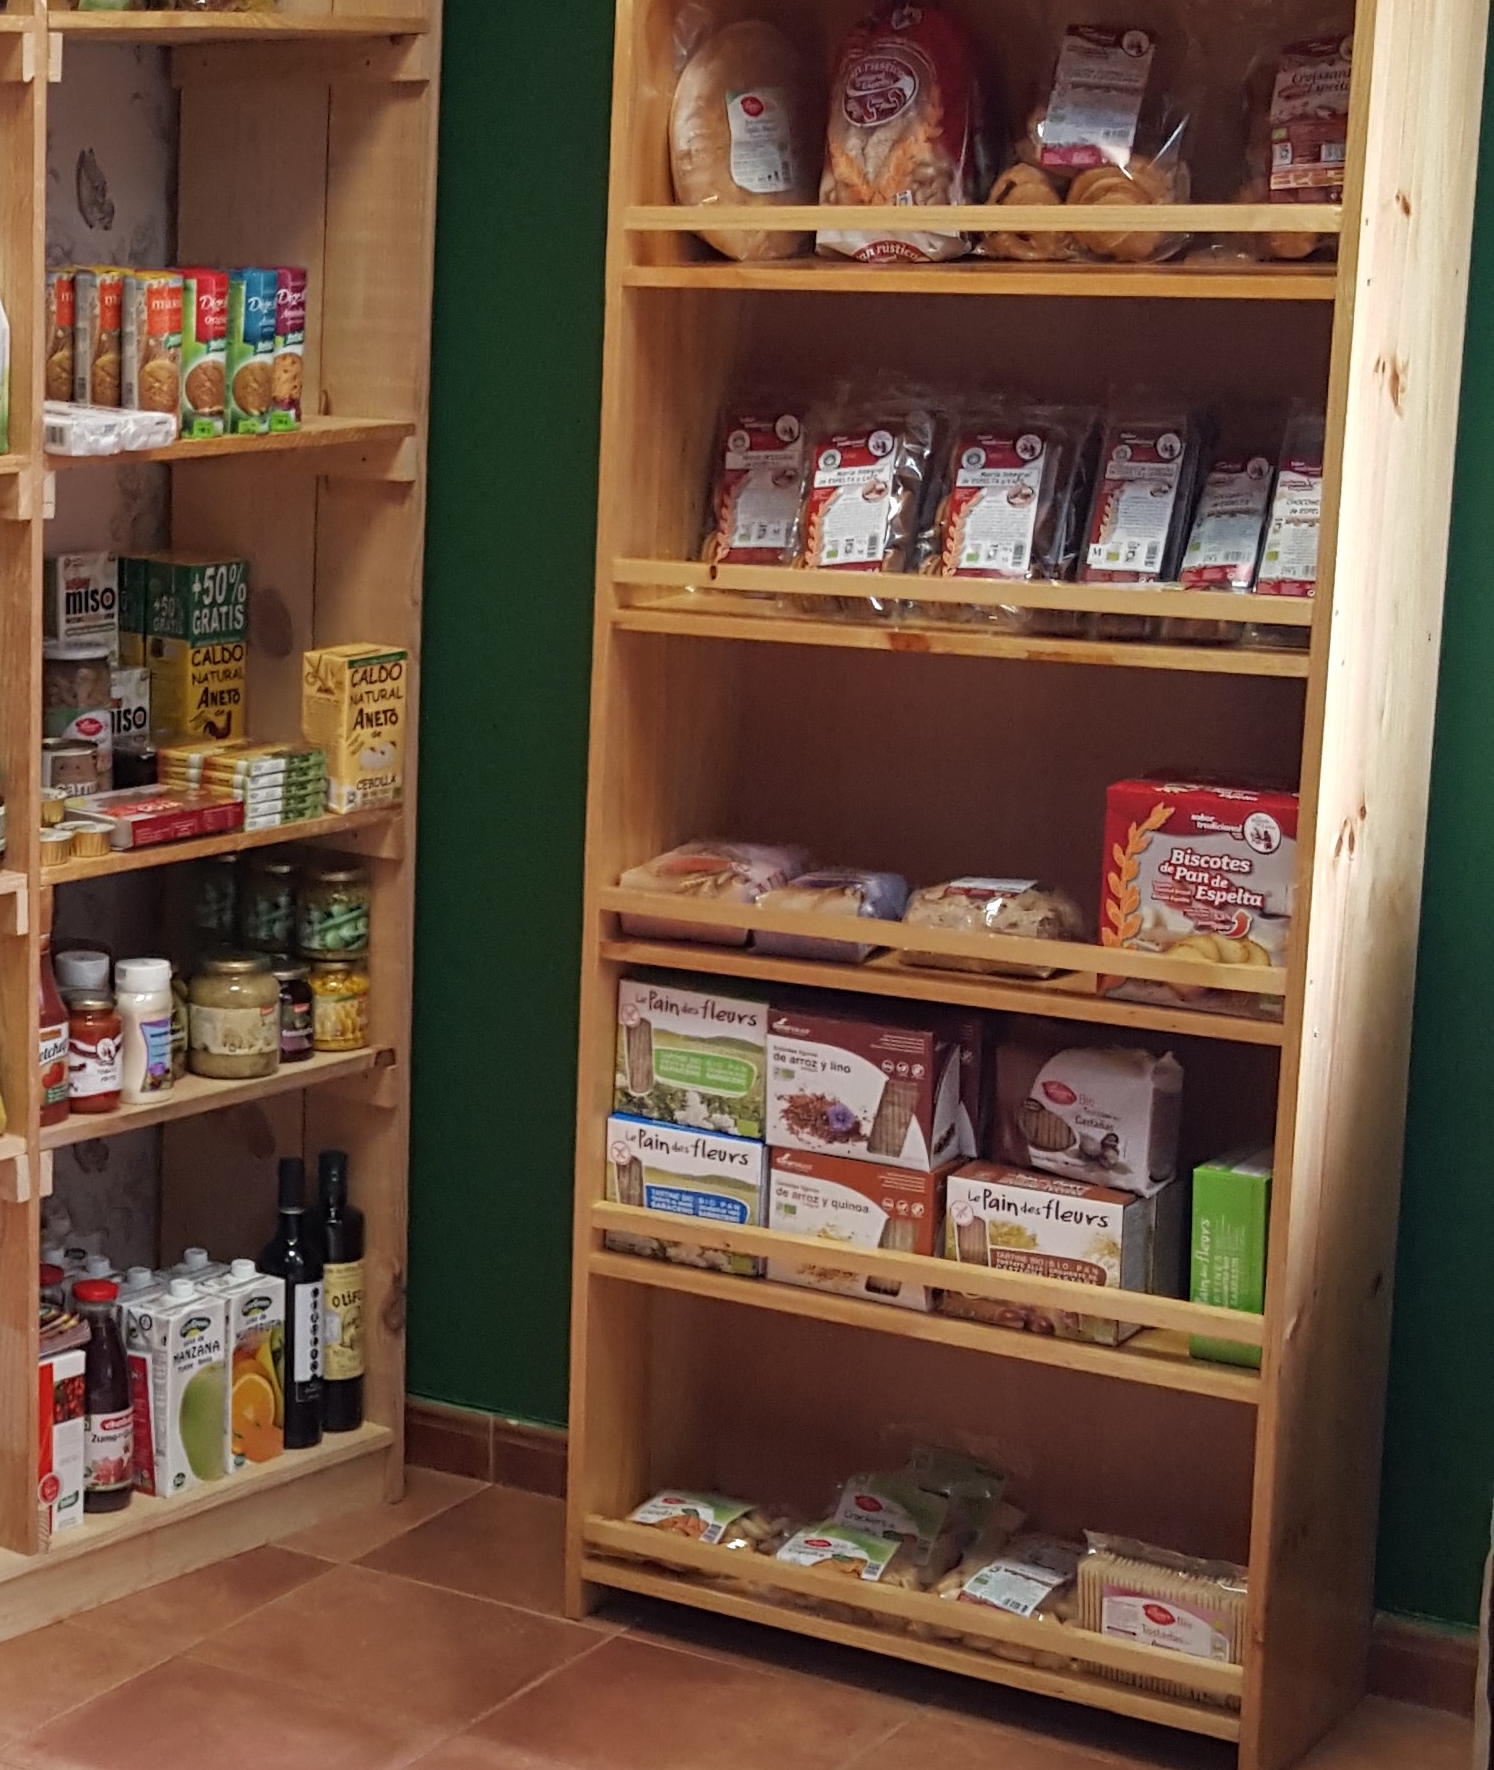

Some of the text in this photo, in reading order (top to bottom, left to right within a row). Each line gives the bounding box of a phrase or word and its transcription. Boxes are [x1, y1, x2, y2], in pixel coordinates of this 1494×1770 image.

[191, 562, 248, 606] +50%
[65, 587, 116, 616] miso
[191, 602, 245, 635] GRATIS
[191, 643, 244, 668] CALDO
[191, 667, 244, 686] NATURAL
[350, 661, 404, 688] CALDO
[349, 685, 404, 706] NATURAL
[356, 776, 397, 791] CEBOLLA
[1171, 848, 1252, 874] Biscotes
[1159, 862, 1229, 889] de Pan de
[1195, 885, 1263, 907] Espelta
[648, 990, 680, 1017] Pain
[699, 998, 759, 1028] fleurs
[772, 1052, 786, 1064] de
[788, 1055, 818, 1069] arroz
[829, 1061, 852, 1074] lino
[637, 1129, 670, 1156] Pain
[690, 1139, 750, 1167] fleurs
[774, 1185, 789, 1198] de
[790, 1190, 819, 1205] arroz
[830, 1196, 870, 1214] quinoa
[981, 1188, 1019, 1217] Pain
[1041, 1201, 1110, 1229] fleurs
[173, 1340, 222, 1365] MANZANA
